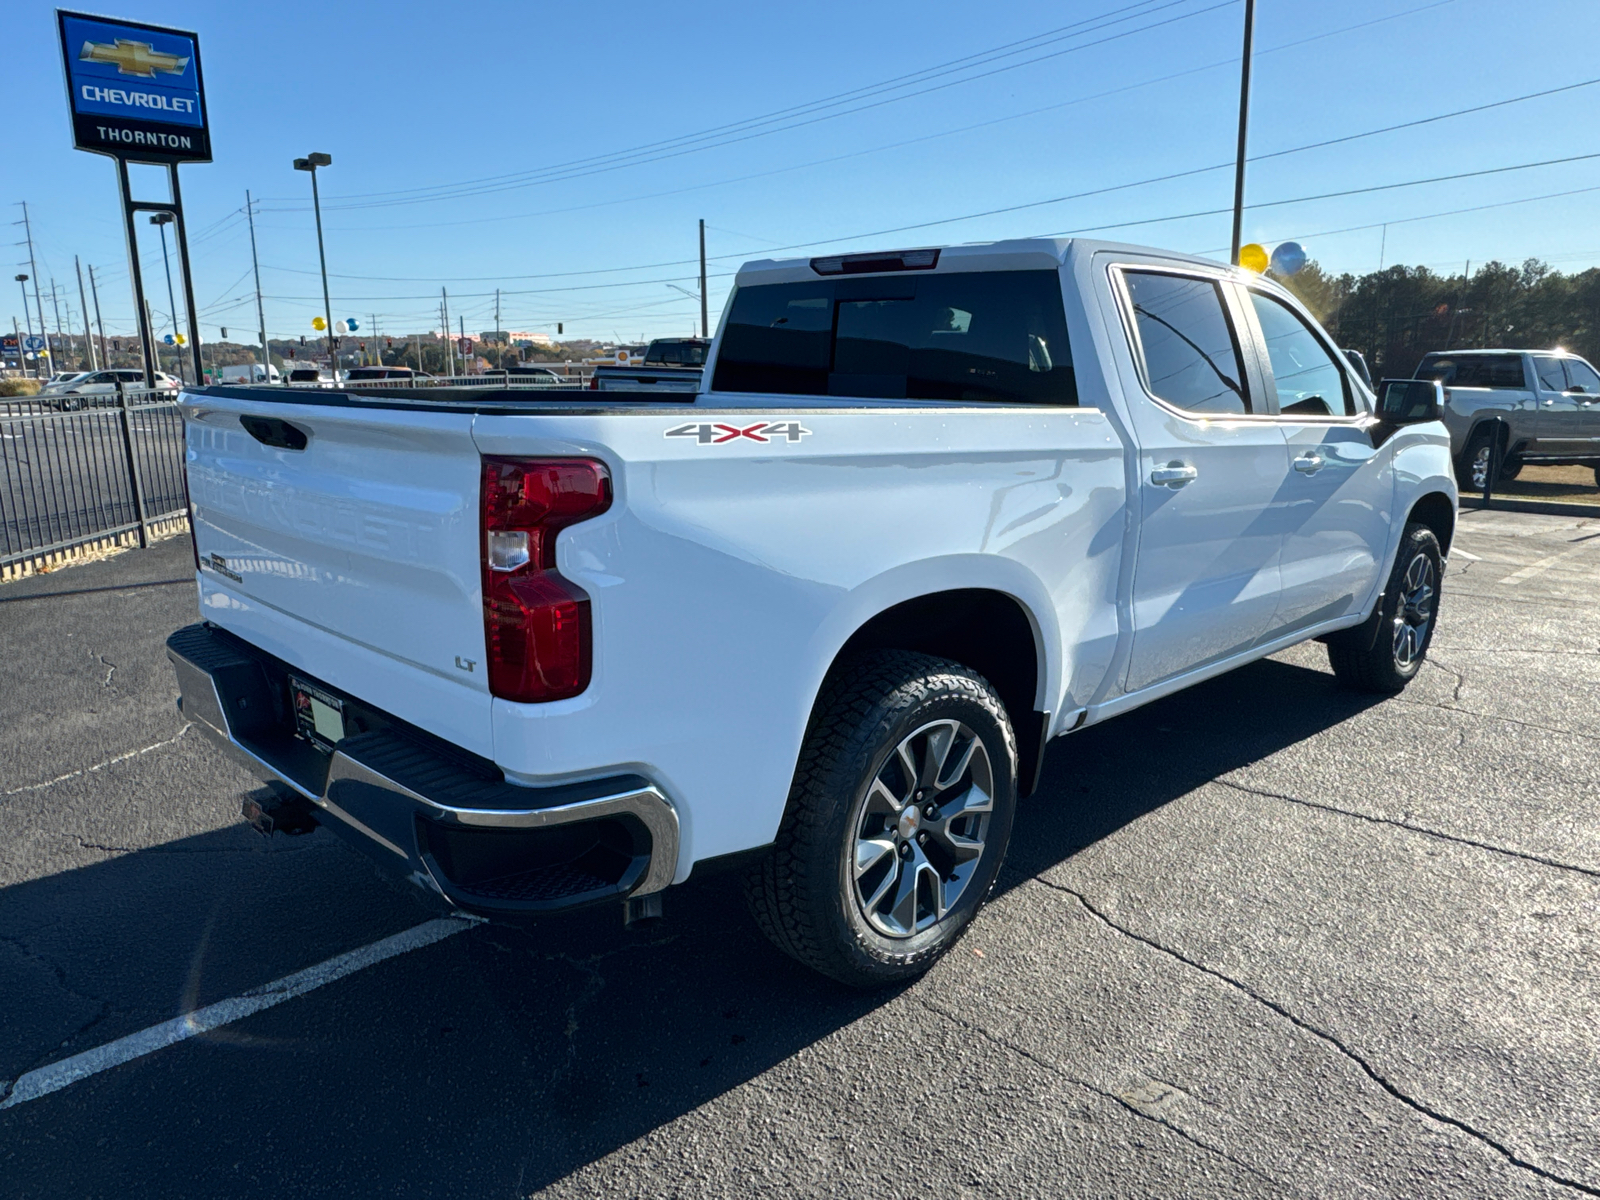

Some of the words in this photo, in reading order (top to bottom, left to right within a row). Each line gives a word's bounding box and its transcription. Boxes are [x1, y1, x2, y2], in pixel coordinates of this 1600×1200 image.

[81, 85, 195, 114] CHEVROLET
[97, 126, 191, 149] THORNTON
[455, 655, 477, 673] LT
